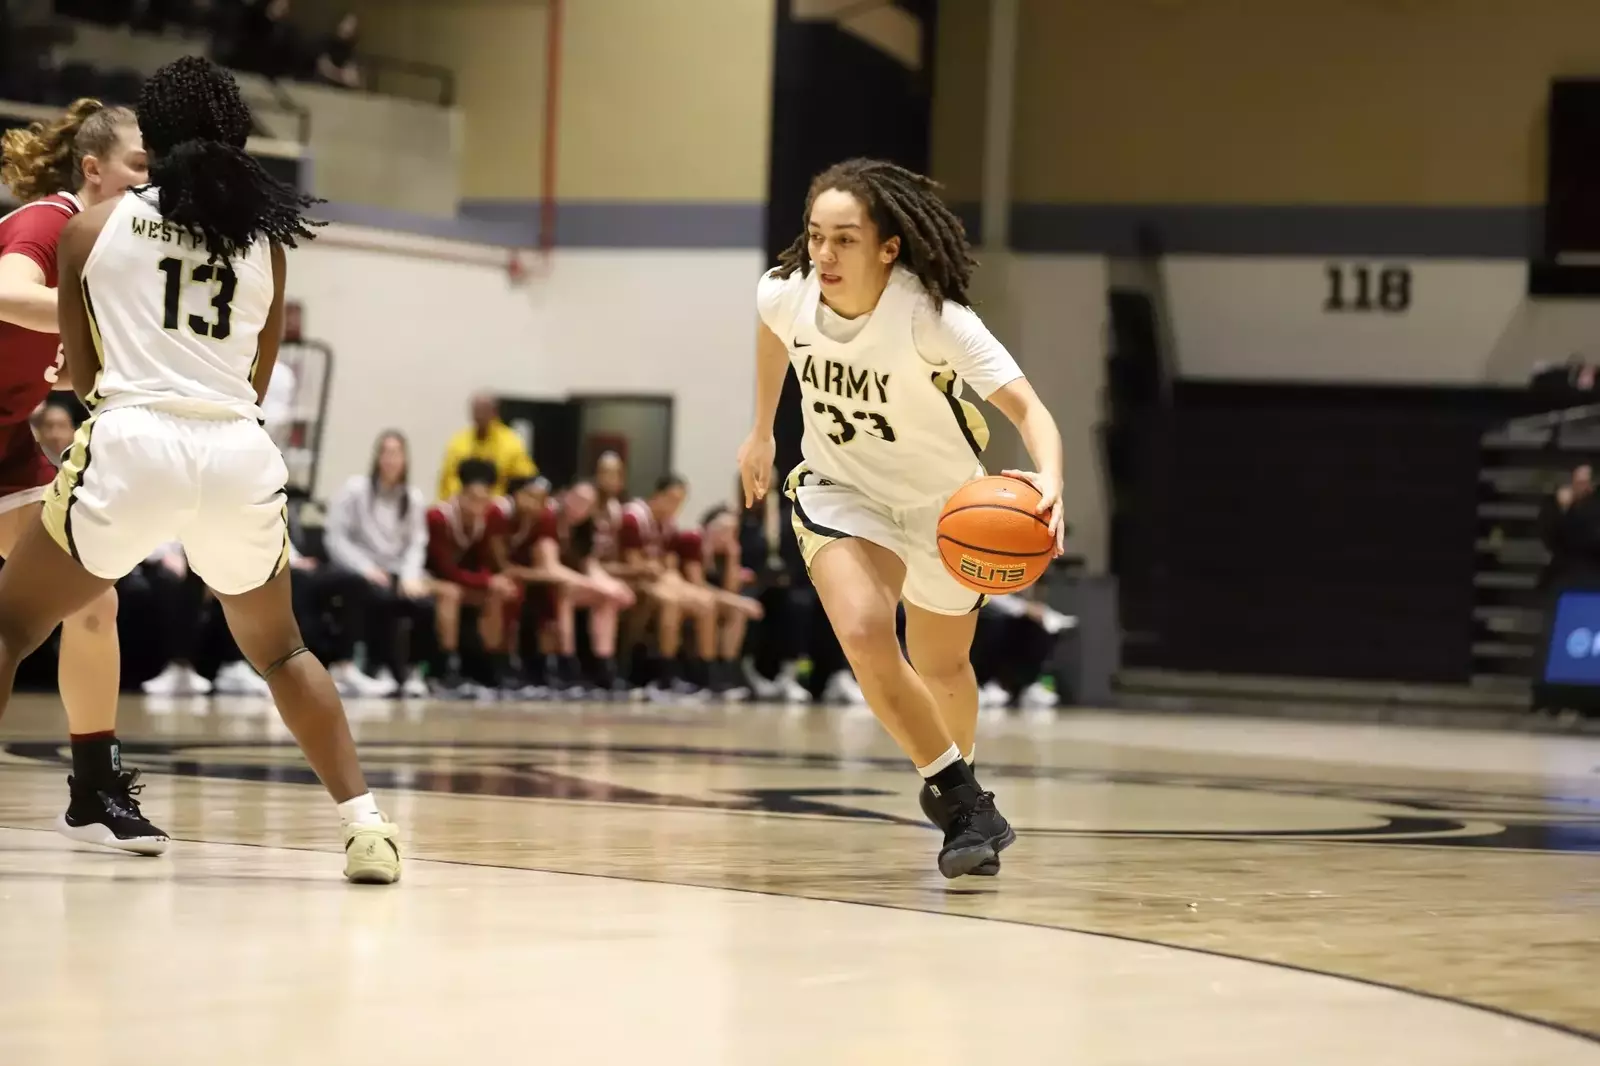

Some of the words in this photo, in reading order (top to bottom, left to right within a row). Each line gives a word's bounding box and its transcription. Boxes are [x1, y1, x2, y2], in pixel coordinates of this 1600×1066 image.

[131, 215, 187, 246] WEST
[158, 256, 236, 340] 13
[1324, 265, 1411, 313] 118
[801, 354, 890, 404] ARMY
[813, 401, 896, 446] 33
[960, 558, 1025, 582] ELITE
